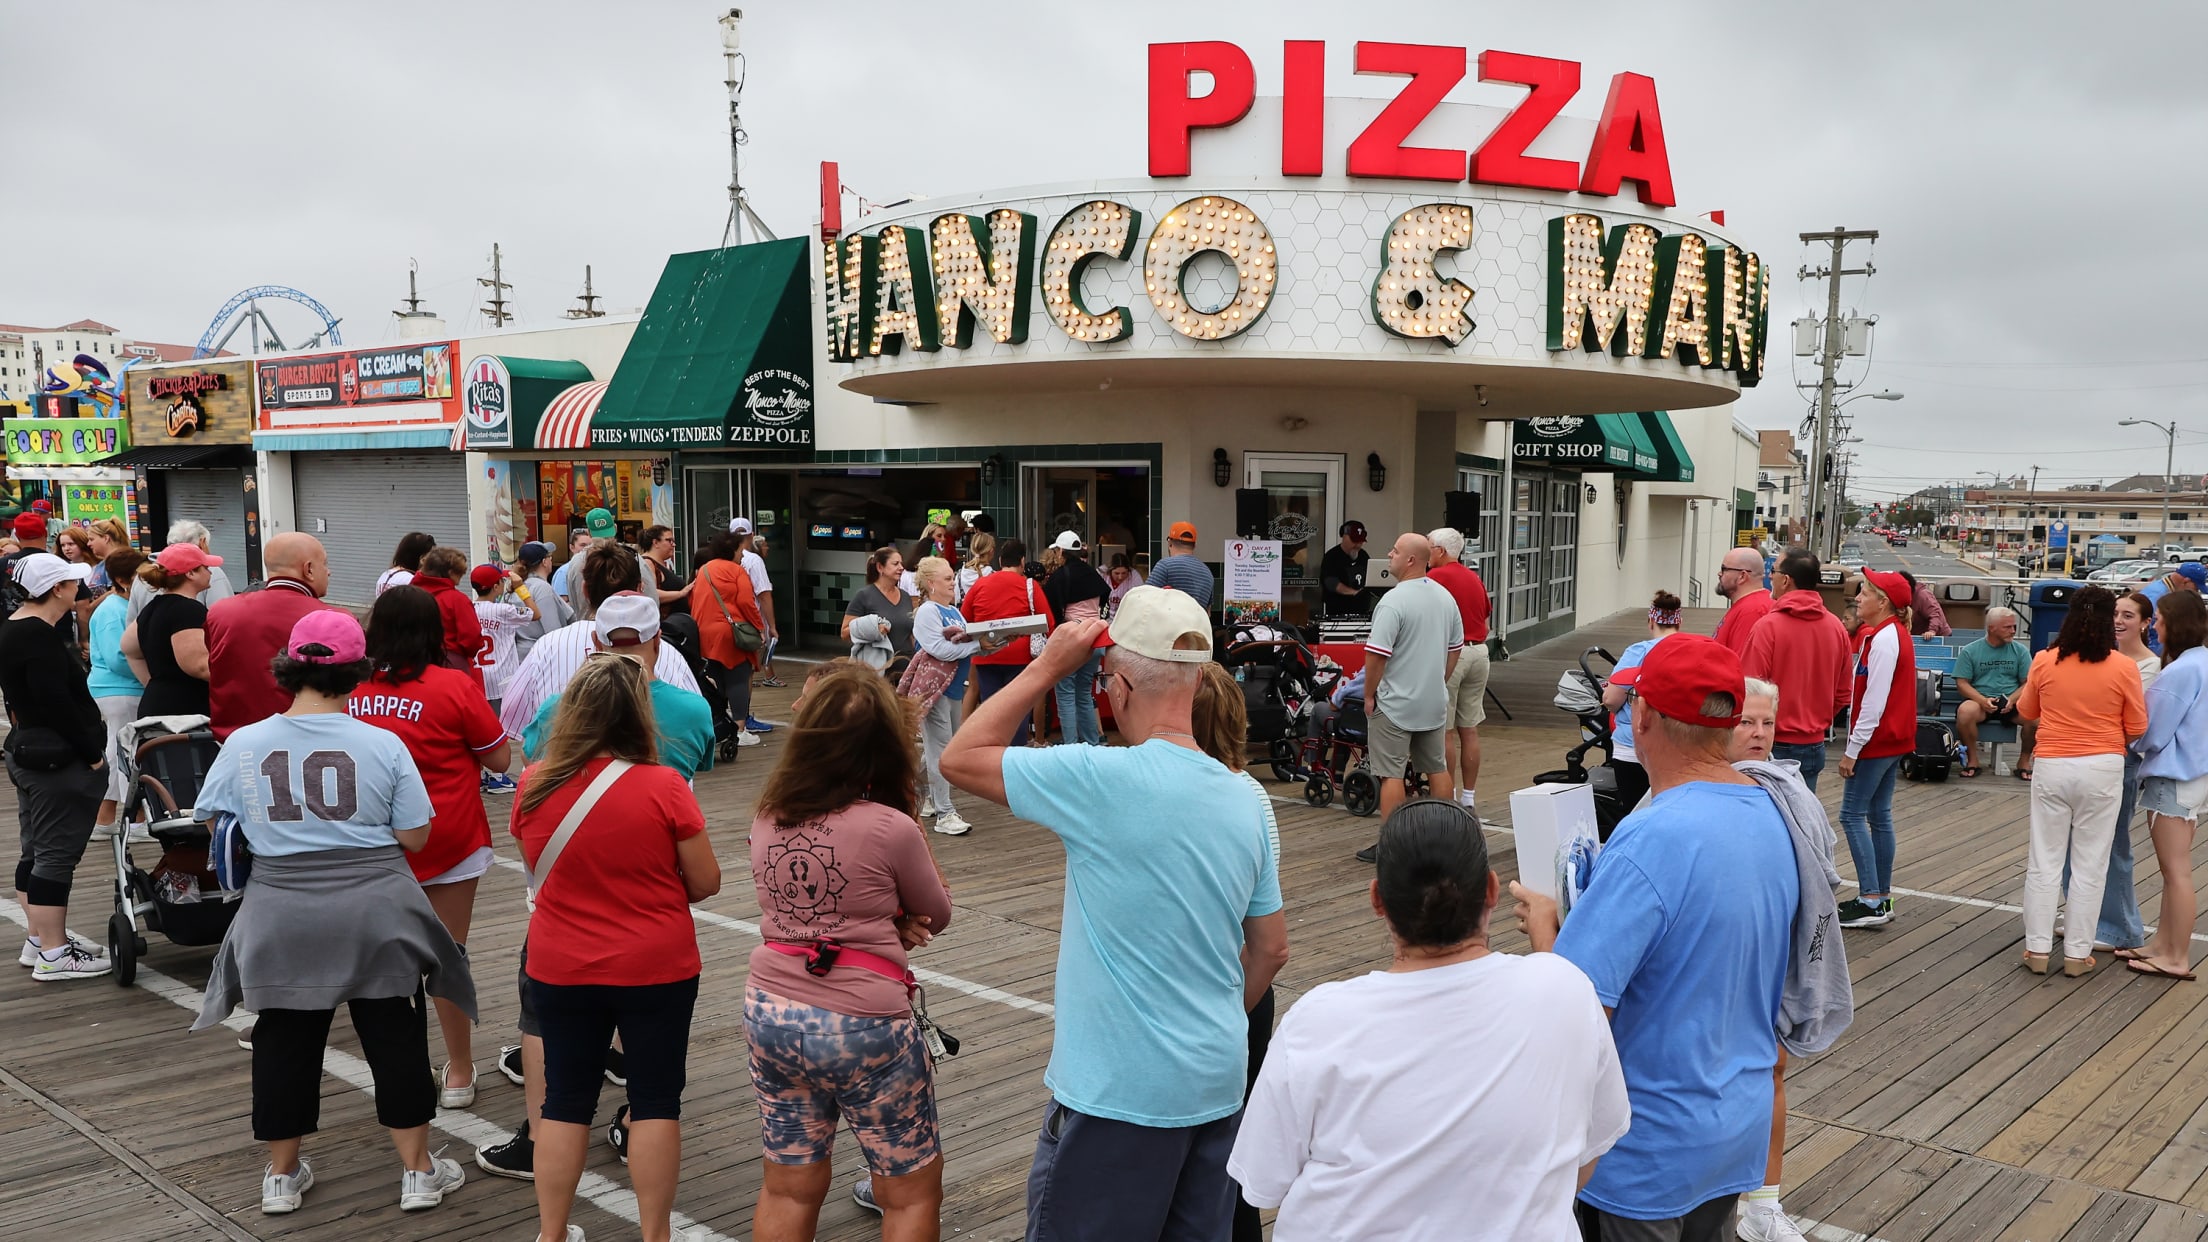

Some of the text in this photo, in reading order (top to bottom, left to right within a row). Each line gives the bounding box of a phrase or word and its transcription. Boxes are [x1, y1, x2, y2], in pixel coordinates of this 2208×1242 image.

[1148, 40, 1677, 207] PIZZA
[824, 194, 1770, 388] MANCO & MAN
[278, 366, 308, 386] BURGER
[309, 363, 336, 384] BOYZZ
[358, 357, 372, 377] ICE
[373, 353, 407, 375] CREAM
[744, 369, 811, 390] BEST OF THE BEST
[287, 389, 329, 400] SPORTS BAR
[472, 380, 501, 406] Rita's
[7, 428, 117, 454] GOOFY GOLF
[591, 426, 811, 443] FRIES WINGS TENDERS ZEPPOLE
[1513, 443, 1554, 458] GIFT
[1557, 443, 1603, 458] SHOP
[67, 489, 122, 500] GOOFY GOLF
[79, 503, 114, 512] ONLY $5
[474, 635, 496, 668] 2
[348, 694, 424, 722] HARPER
[260, 748, 358, 823] 10
